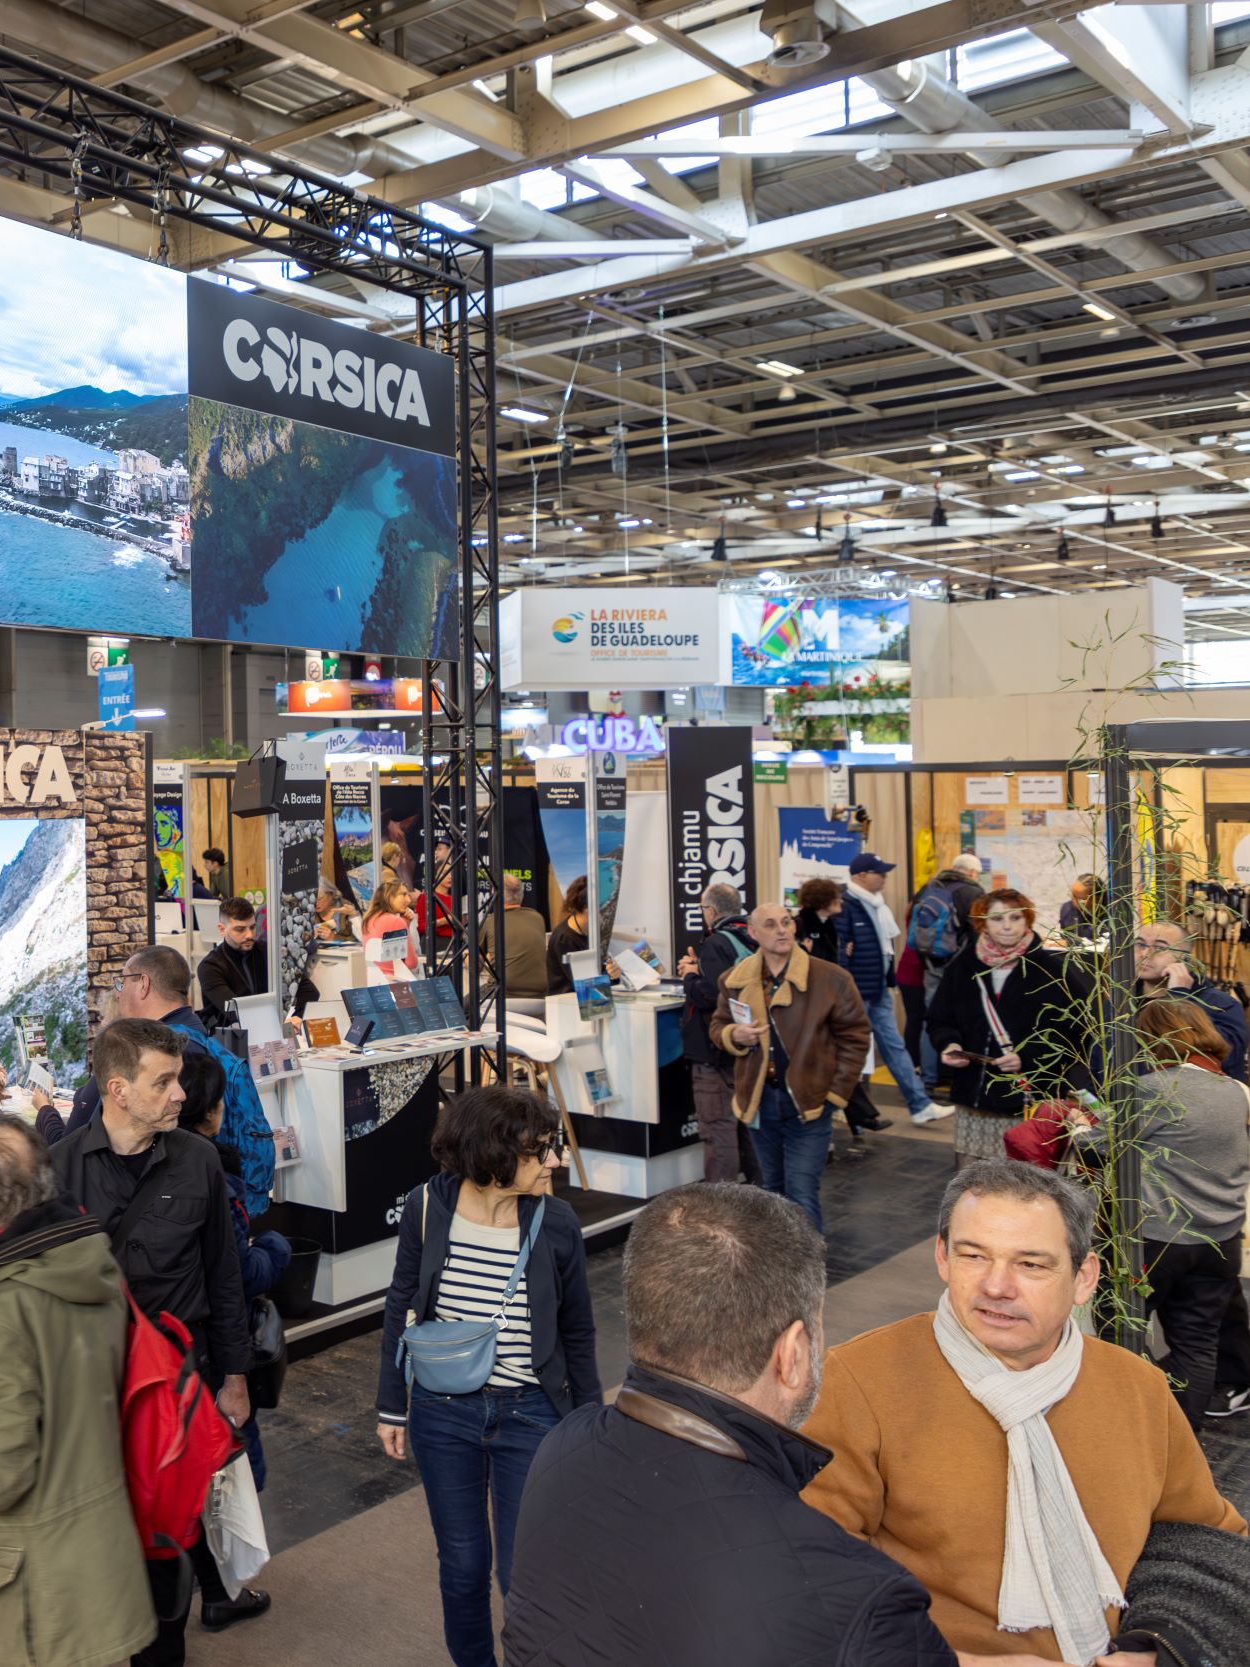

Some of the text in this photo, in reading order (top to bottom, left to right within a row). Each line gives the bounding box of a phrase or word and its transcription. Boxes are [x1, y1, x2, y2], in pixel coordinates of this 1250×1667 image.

[222, 318, 431, 427] CORSICA
[590, 609, 668, 621] LA RIVIERA
[590, 622, 645, 634] DES ILES
[590, 634, 700, 647] DE GUADELOUPE
[797, 651, 863, 663] MARTINIQUE
[102, 693, 131, 705] ENTRÉE
[562, 715, 667, 754] CUBA
[282, 792, 322, 805] A Boxetta
[705, 764, 748, 915] RSICA
[678, 810, 708, 932] mi chjamu
